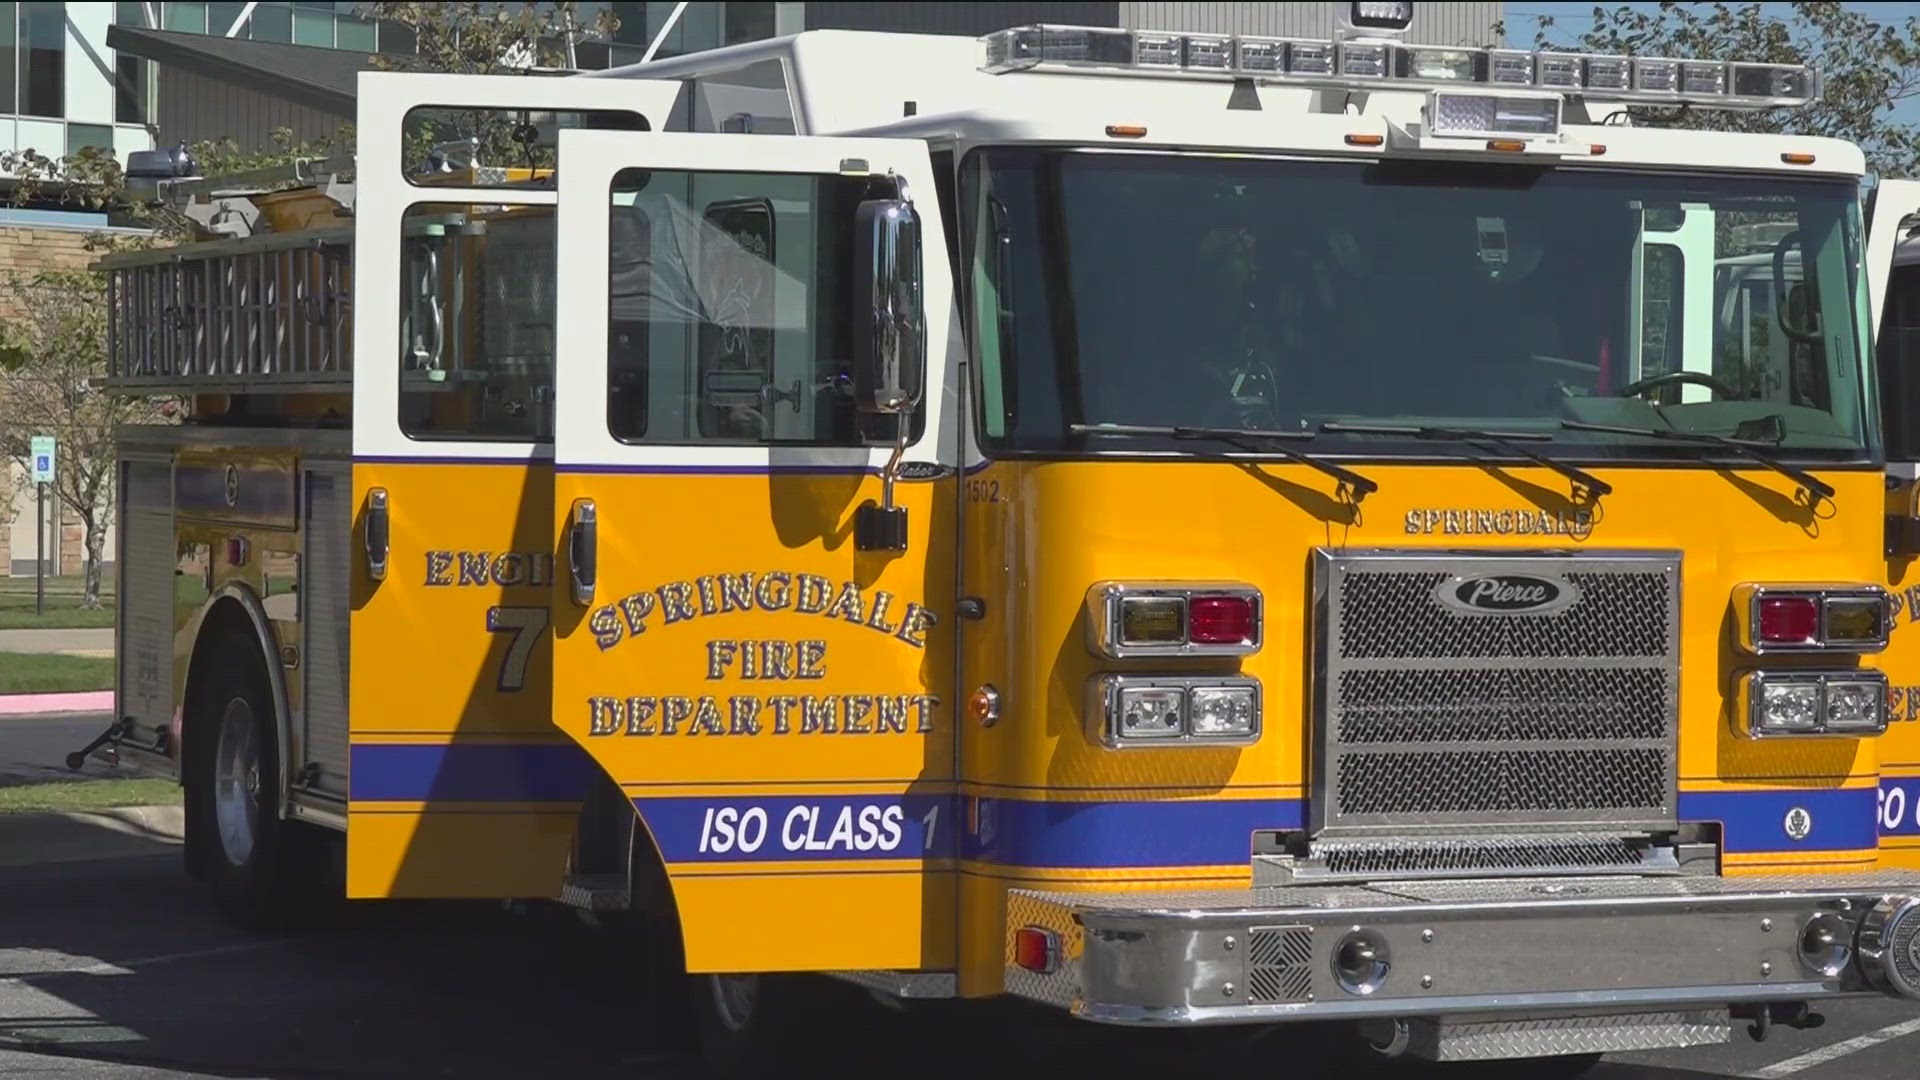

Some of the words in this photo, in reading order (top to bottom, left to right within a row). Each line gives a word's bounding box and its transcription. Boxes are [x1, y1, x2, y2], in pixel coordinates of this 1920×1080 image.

[966, 481, 999, 503] 1502
[1405, 509, 1591, 535] SPRINGDALE
[424, 551, 553, 586] ENGI
[589, 571, 938, 652] SPRINGDALE
[1468, 578, 1546, 606] Pierce
[486, 606, 549, 692] 7
[705, 640, 826, 680] FIRE
[588, 694, 941, 736] DEPARTMENT
[699, 807, 768, 853] ISO
[782, 805, 904, 851] CLASS
[922, 806, 939, 849] 1
